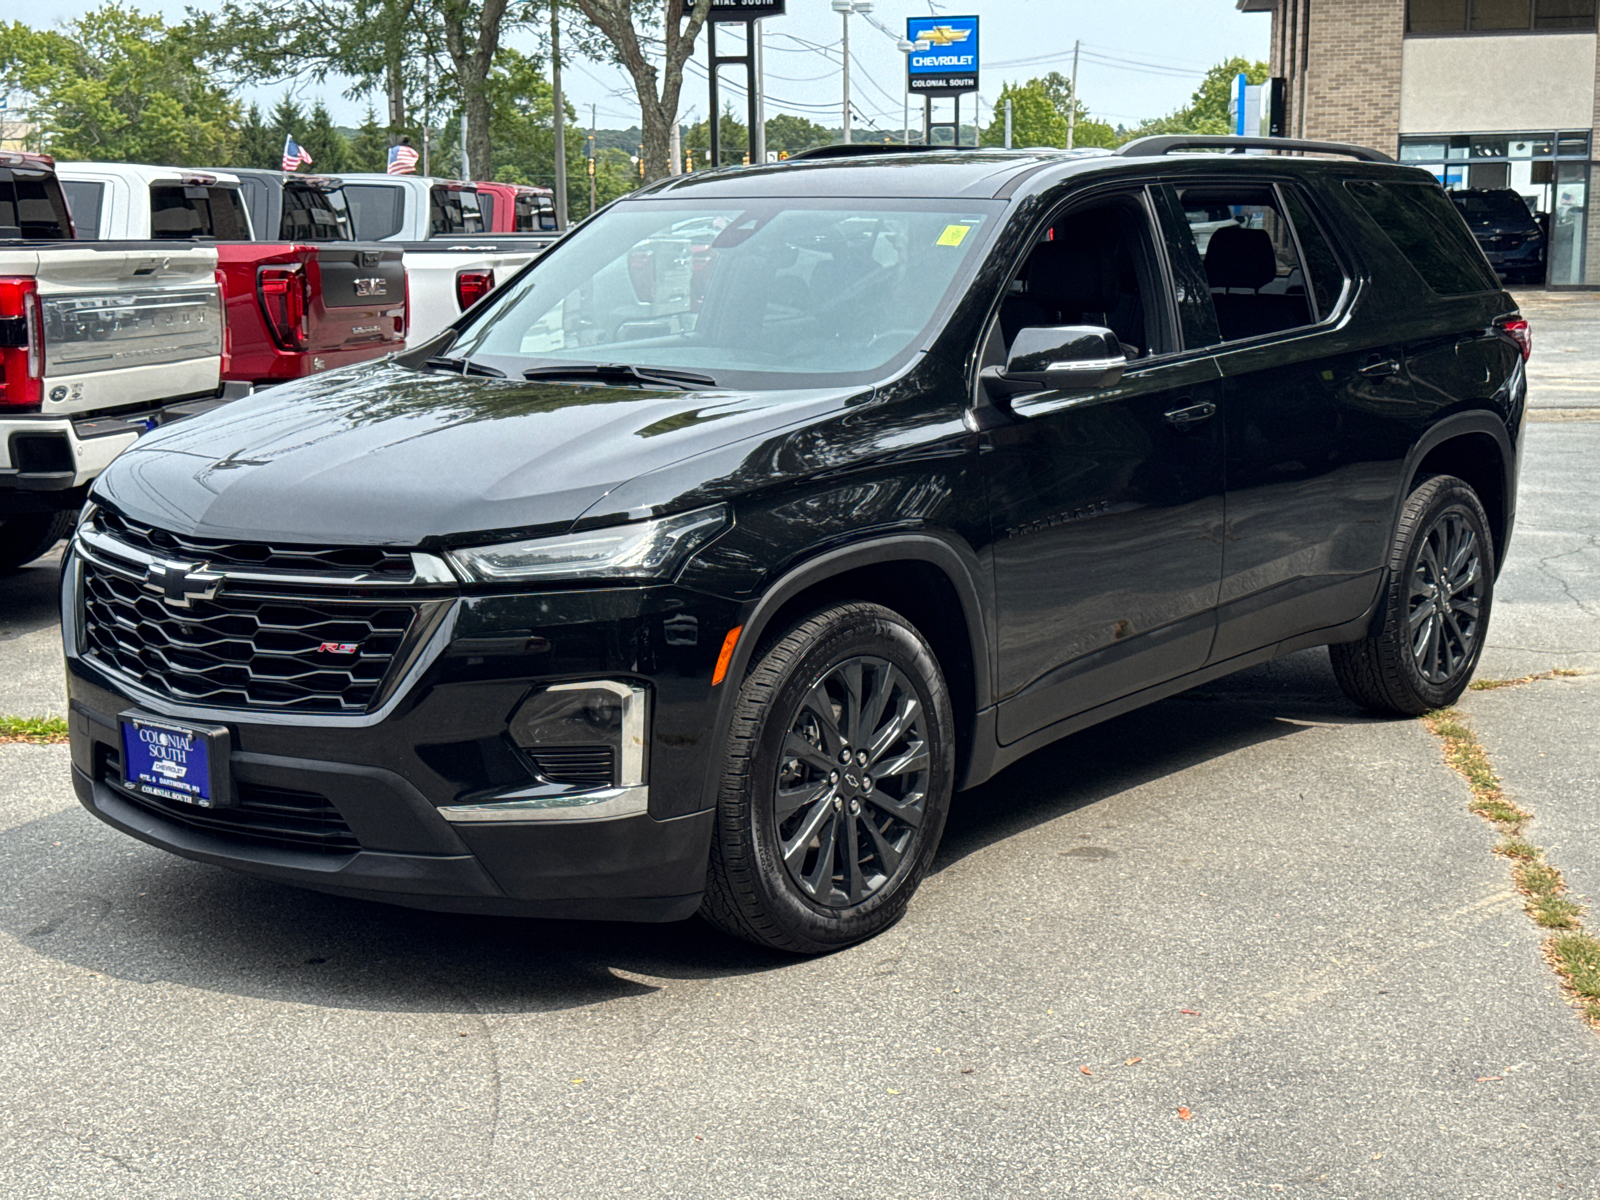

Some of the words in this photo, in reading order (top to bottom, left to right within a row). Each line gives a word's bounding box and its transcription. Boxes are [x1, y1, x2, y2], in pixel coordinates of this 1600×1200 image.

[912, 55, 974, 67] CHEVROLET
[353, 278, 387, 296] GMC
[75, 312, 206, 335] PLATINUM
[1005, 500, 1109, 540] TRAVERSE
[317, 641, 359, 655] RS
[139, 728, 194, 752] COLONIAL
[148, 743, 188, 764] SOUTH
[155, 763, 184, 775] CHEVROLET
[141, 785, 171, 799] COLONIAL
[171, 793, 193, 804] SOUTH
[192, 785, 201, 793] MA
